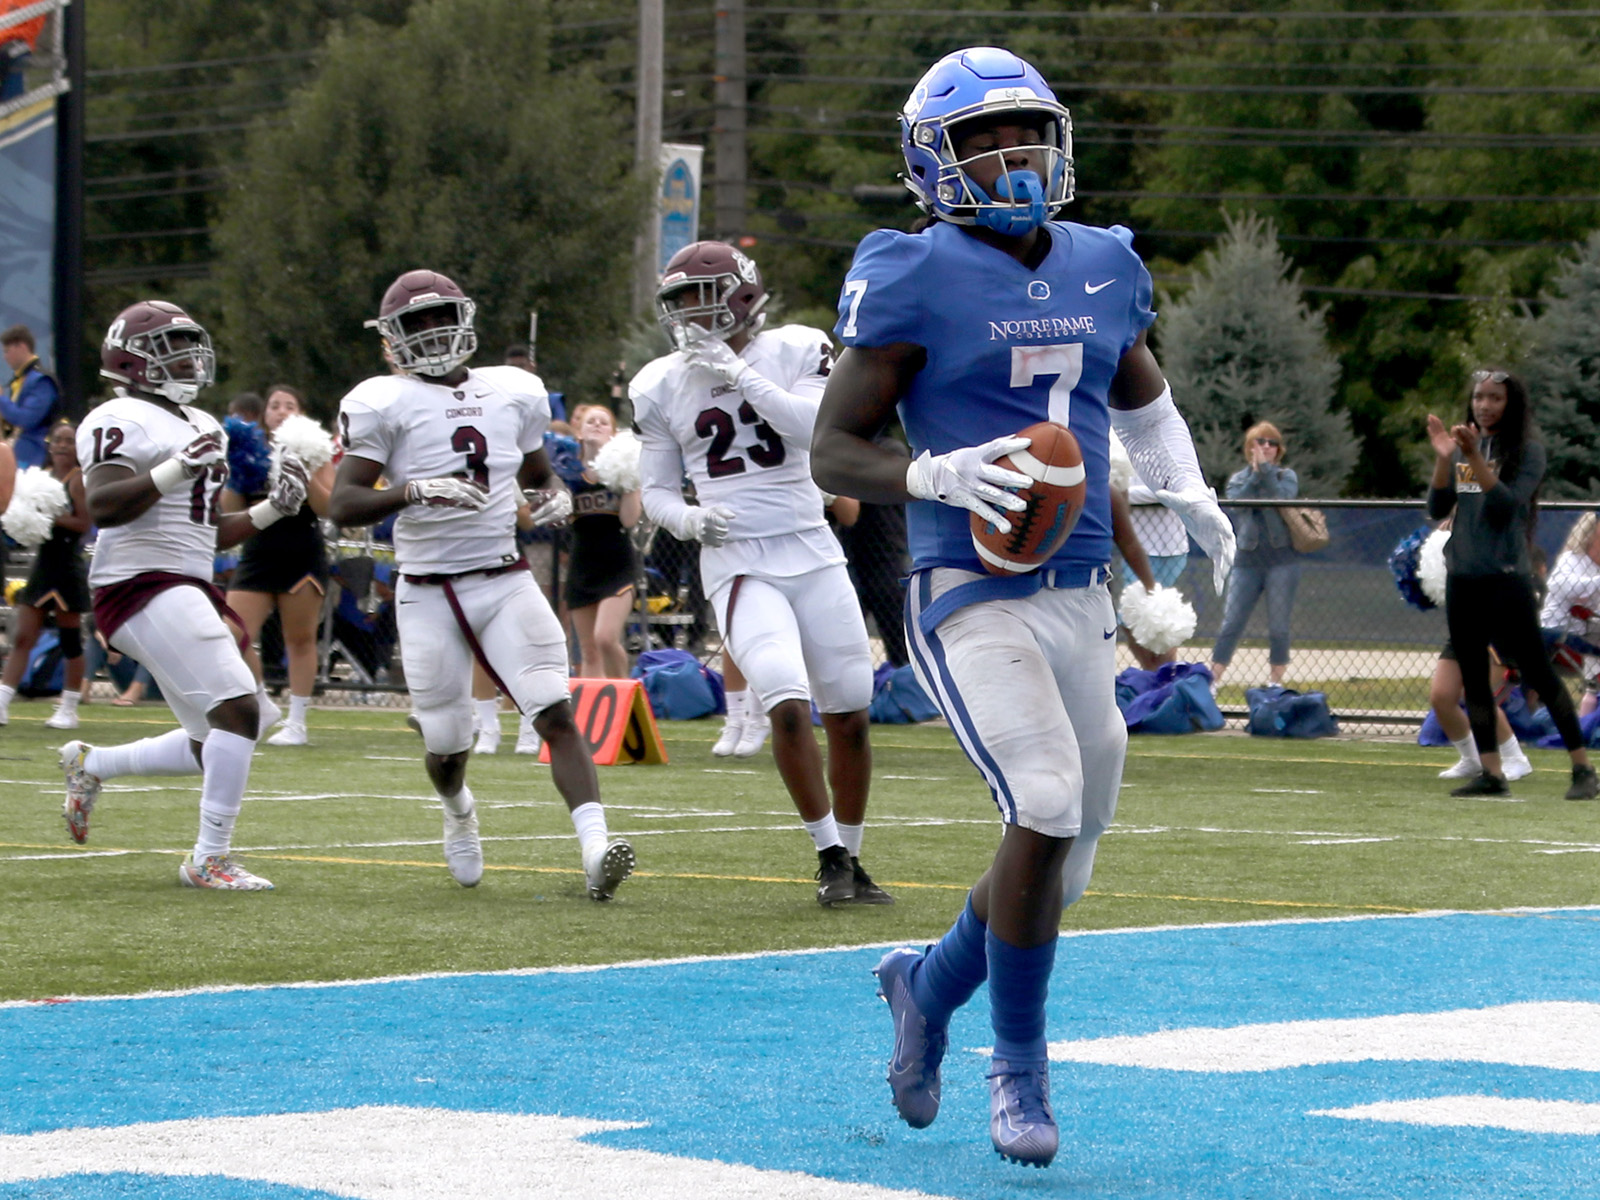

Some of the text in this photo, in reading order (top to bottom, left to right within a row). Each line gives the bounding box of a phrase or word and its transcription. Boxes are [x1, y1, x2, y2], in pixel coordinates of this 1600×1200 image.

[843, 279, 869, 337] 7
[988, 316, 1097, 340] NOTRE DAME
[1016, 328, 1078, 339] COLLEGE
[1010, 342, 1084, 428] 7
[445, 406, 483, 419] CONCORD
[92, 426, 125, 462] 12
[450, 425, 490, 492] 3
[695, 400, 786, 479] 23
